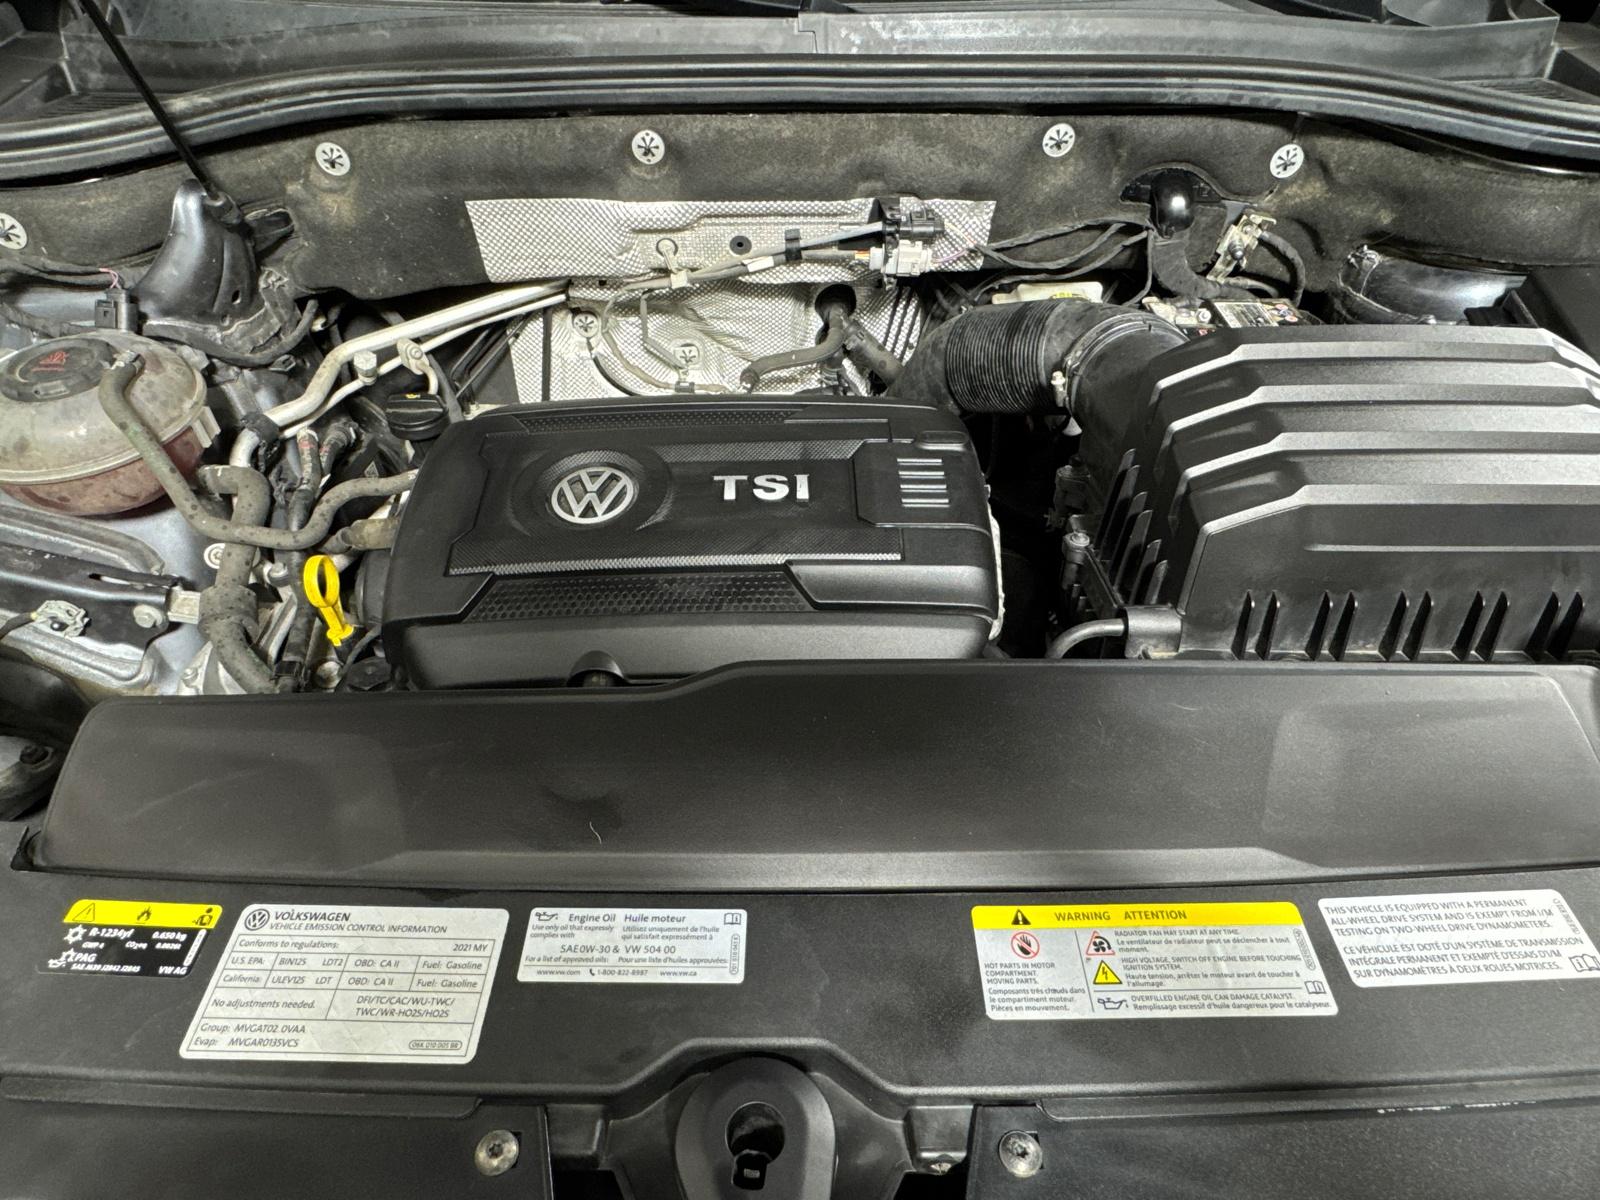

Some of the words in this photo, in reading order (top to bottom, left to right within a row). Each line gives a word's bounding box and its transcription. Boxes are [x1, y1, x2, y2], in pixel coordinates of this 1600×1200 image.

[713, 474, 810, 501] TSI
[1324, 906, 1346, 915] THIS
[1346, 905, 1384, 914] VEHICLE
[1384, 904, 1394, 912] IS
[1394, 902, 1440, 913] EQUIPPED
[1440, 901, 1465, 910] WITH
[1466, 901, 1474, 909] A
[1474, 899, 1527, 908] PERMANENT
[274, 911, 352, 921] VOLKSWAGEN
[568, 913, 600, 924] Engine
[602, 913, 616, 922] Oil
[624, 914, 649, 923] Huile
[650, 914, 687, 923] moteur
[1054, 911, 1111, 921] WARNING
[1123, 910, 1187, 921] ATTENTION
[1331, 915, 1382, 925] ALL-WHEEL
[1381, 914, 1409, 924] DRIVE
[1408, 913, 1443, 922] SYSTEM
[1444, 912, 1465, 921] AND
[1465, 911, 1475, 920] IS
[1475, 910, 1510, 920] EXEMPT
[1510, 909, 1537, 918] FROM
[1537, 908, 1554, 917] I/M
[270, 922, 304, 931] VEHICLE
[304, 922, 345, 931] EMISSION
[346, 923, 385, 932] CONTROL
[387, 924, 448, 933] INFORMATION
[545, 924, 560, 932] only
[1335, 927, 1373, 936] TESTING
[1374, 926, 1390, 935] ON
[1389, 923, 1448, 934] TWO-WHEEL
[1448, 922, 1476, 932] DRIVE
[1475, 920, 1552, 931] DYNAMOMETERS.
[530, 932, 559, 940] complies
[661, 933, 707, 941] expressément
[239, 938, 279, 949] Conforms
[280, 940, 290, 949] to
[291, 940, 340, 951] regulations:
[452, 943, 472, 952] 2021
[472, 943, 489, 952] MY
[560, 944, 580, 954] SAE
[579, 944, 611, 954] 0W-30
[612, 945, 620, 954] &
[624, 945, 643, 954] VW
[643, 945, 662, 954] 504
[663, 945, 677, 954] 00
[1343, 945, 1356, 955] CE
[1355, 943, 1401, 954] VÉHICULE
[1400, 943, 1416, 953] EST
[1416, 940, 1442, 952] DOTÉ
[1441, 941, 1467, 951] D'UN
[1466, 939, 1505, 950] SYSTÈME
[1504, 938, 1519, 948] DE
[1518, 937, 1584, 948] TRANSMISSION
[75, 952, 98, 963] PAG
[230, 956, 246, 965] U.S.
[279, 957, 307, 966] BIN125
[321, 958, 344, 967] LDT2
[561, 956, 595, 964] approved
[1348, 955, 1397, 967] INTÉGRALE
[1396, 953, 1450, 965] PERMANENT
[1450, 953, 1461, 962] ET
[1461, 950, 1501, 962] EXEMPTÉ
[1500, 950, 1537, 960] D'ESSAIS
[354, 959, 376, 968] OBD:
[379, 959, 392, 968] CA
[393, 960, 400, 969] II
[422, 960, 442, 969] Fuel:
[445, 960, 483, 970] Gasoline
[158, 965, 175, 975] VW
[173, 966, 188, 976] AG
[1354, 968, 1374, 979] SUR
[1373, 965, 1449, 978] DYNAMOMÈTRES
[1448, 963, 1457, 974] À
[1456, 963, 1485, 974] DEUX
[1484, 962, 1515, 972] ROUES
[1514, 960, 1562, 972] MOTRICES.
[271, 975, 306, 984] ULEV125
[314, 976, 333, 985] LDT
[347, 976, 370, 986] OBD:
[373, 977, 386, 986] CA
[387, 977, 394, 986] II
[416, 978, 437, 988] Fuel:
[440, 979, 478, 989] Gasoline
[986, 977, 1015, 985] MOVING
[988, 987, 1030, 995] Composants
[211, 998, 225, 1008] No
[226, 998, 280, 1010] adjustments
[281, 999, 316, 1009] needed.
[997, 996, 1048, 1004] compartiment
[991, 1004, 1014, 1012] Pièces
[1133, 1004, 1177, 1012] Remplissage
[1232, 1002, 1269, 1010] dangereux
[355, 1007, 450, 1018] TWC/WR-HO2S/HO2S
[199, 1022, 231, 1034] Group:
[193, 1036, 218, 1047] Evap:
